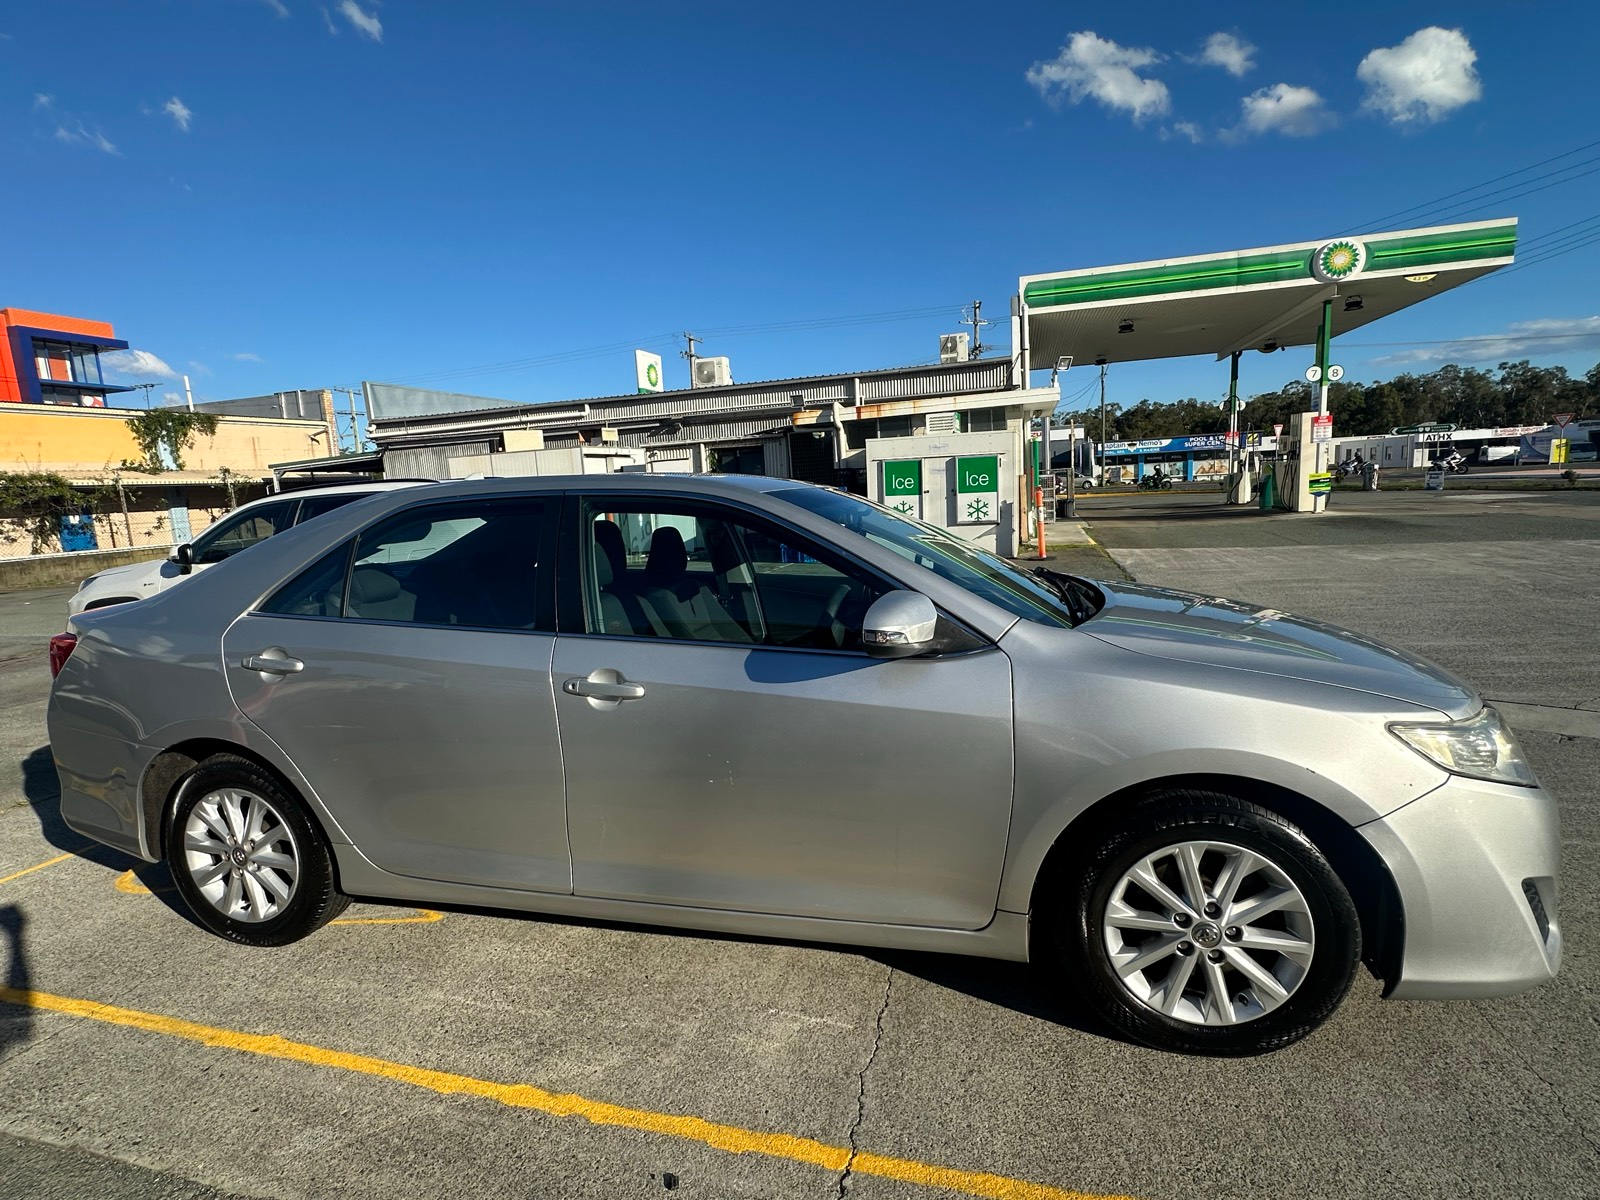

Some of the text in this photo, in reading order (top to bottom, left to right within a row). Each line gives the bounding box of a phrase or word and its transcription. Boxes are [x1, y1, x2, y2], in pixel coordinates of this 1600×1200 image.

[1311, 369, 1318, 378] 7
[1332, 368, 1339, 377] 8
[892, 475, 914, 489] Ice
[965, 471, 989, 486] Ice
